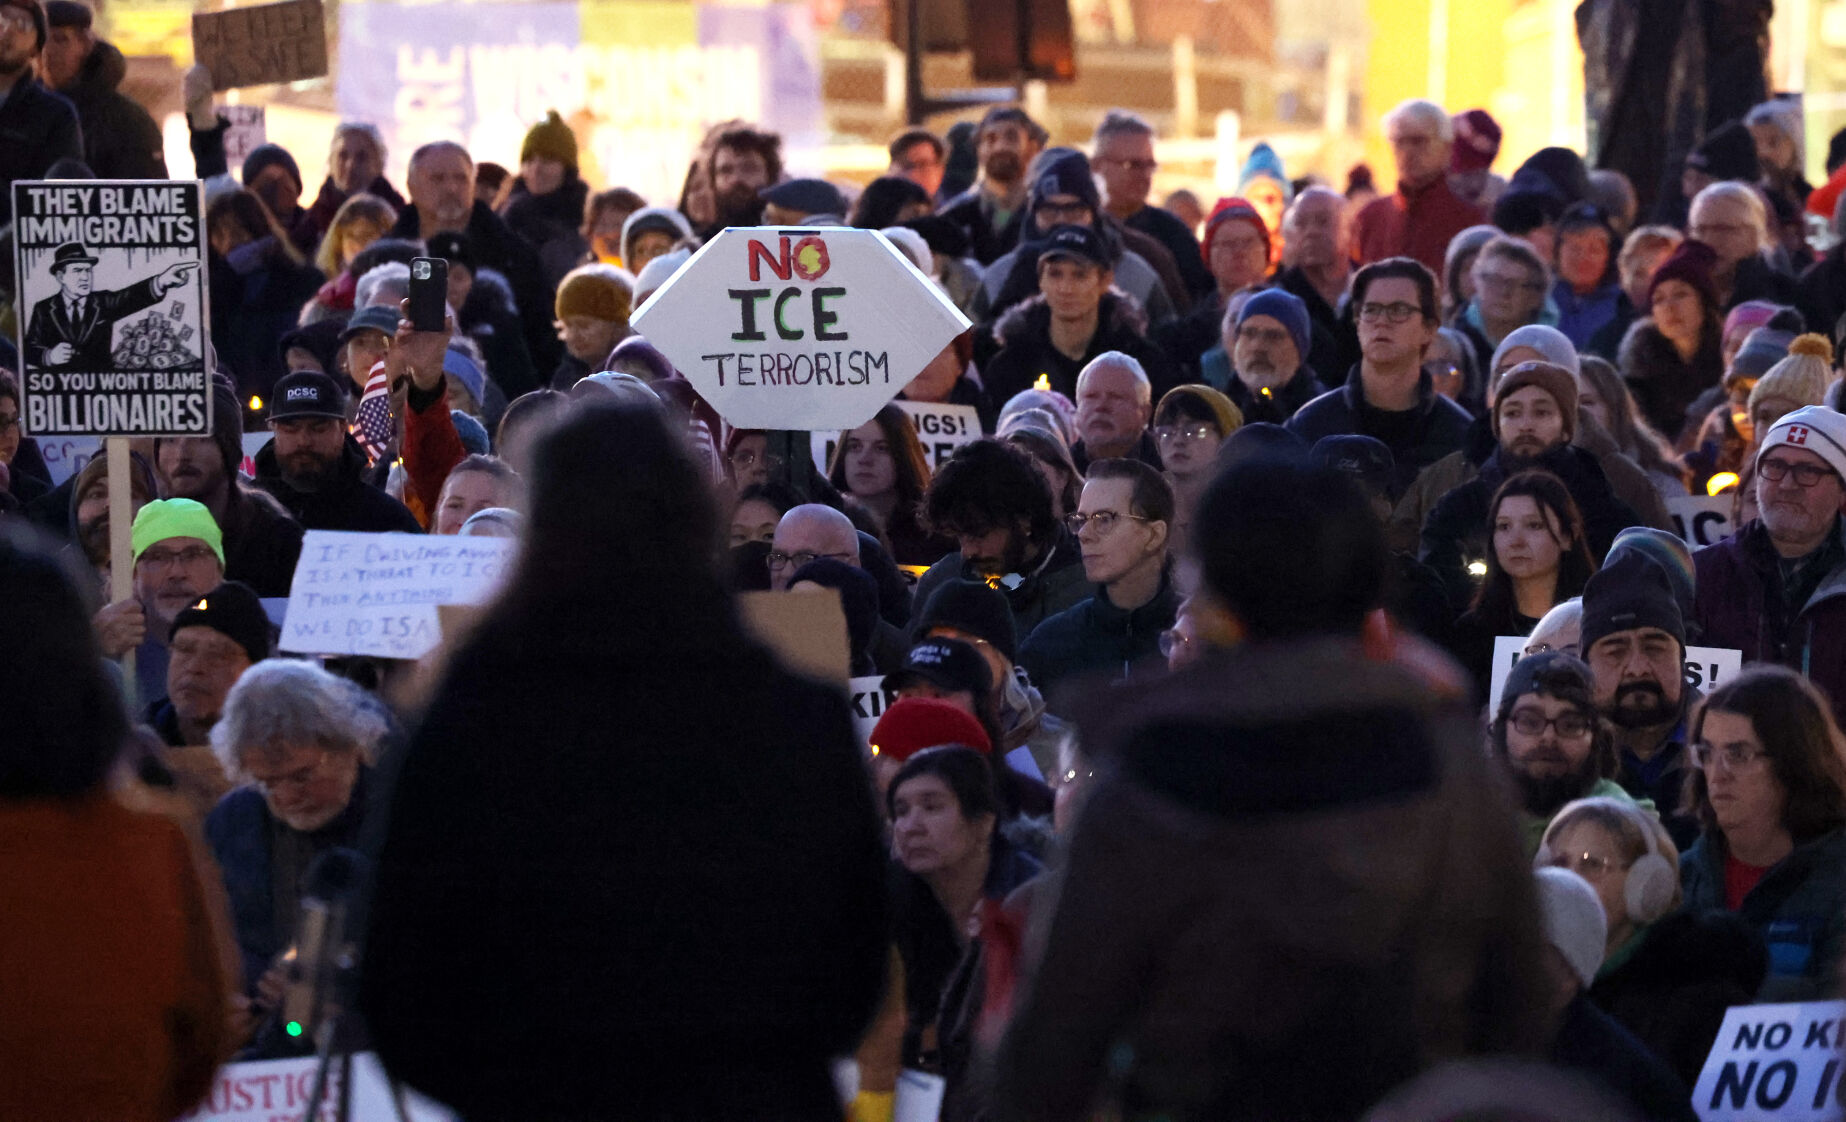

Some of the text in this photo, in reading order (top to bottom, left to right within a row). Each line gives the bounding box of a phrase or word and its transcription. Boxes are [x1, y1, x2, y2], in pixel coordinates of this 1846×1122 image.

[27, 187, 186, 215] THEY BLAME
[20, 215, 195, 244] IMMIGRANTS
[748, 236, 831, 282] NO
[728, 286, 849, 342] ICE
[29, 373, 204, 391] SO YOU WON'T BLAME
[701, 351, 889, 387] TERRORISM
[287, 387, 318, 398] DCSC
[28, 393, 205, 432] BILLIONAIRES
[915, 413, 967, 436] GS!
[319, 543, 350, 562] IF
[429, 563, 456, 577] TO
[345, 618, 374, 637] DO
[1733, 1018, 1846, 1051] NO KI
[1709, 1060, 1798, 1112] NO
